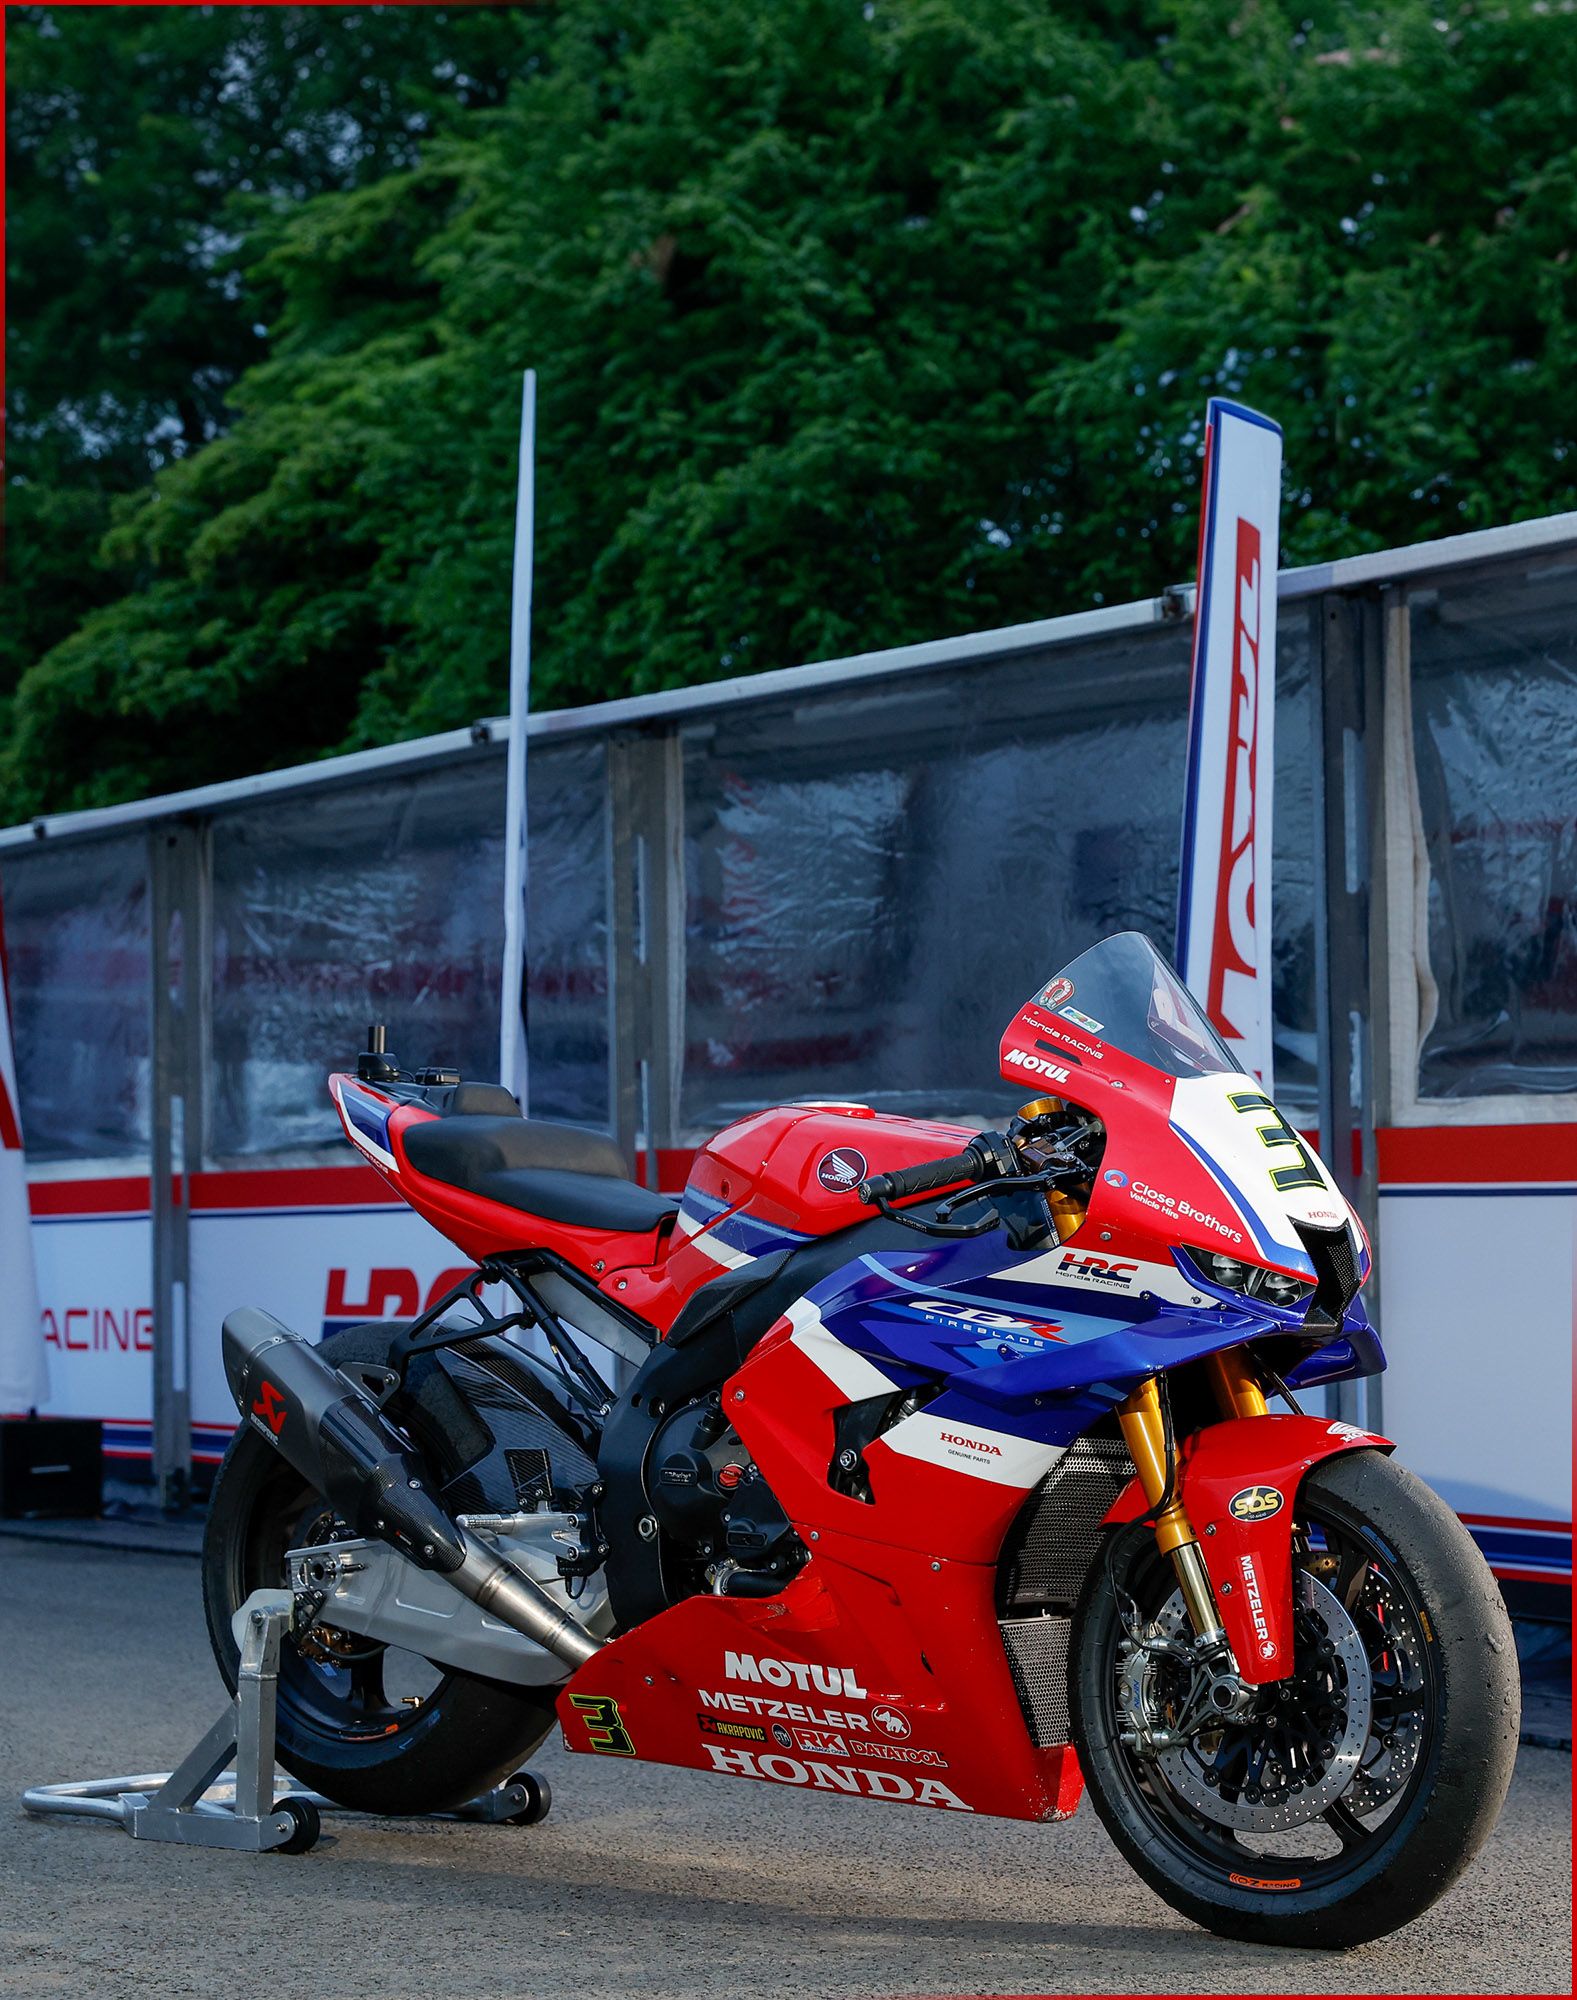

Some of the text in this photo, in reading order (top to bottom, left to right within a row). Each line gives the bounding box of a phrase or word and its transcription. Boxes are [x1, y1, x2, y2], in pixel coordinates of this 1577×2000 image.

[1022, 1015, 1061, 1038] Honda
[1061, 1035, 1104, 1060] RACING
[1003, 1049, 1071, 1084] MOTUL
[1227, 1091, 1328, 1192] 3
[820, 1172, 854, 1186] HONDA
[1130, 1191, 1179, 1220] Vehicle Hire
[1131, 1181, 1243, 1244] Close Brothers
[1056, 1270, 1131, 1289] Honda RACING
[1058, 1253, 1139, 1284] HRC
[908, 1301, 1070, 1345] CBR
[925, 1314, 1045, 1348] FIREBLADE
[940, 1431, 1003, 1457] HONDA
[947, 1449, 991, 1465] GENUINE PARTS
[1240, 1554, 1269, 1641] METZELER
[724, 1650, 868, 1700] MOTUL
[568, 1693, 637, 1756] 3
[698, 1689, 872, 1733] METZELER
[774, 1730, 791, 1743] STM
[795, 1729, 843, 1751] RK
[849, 1740, 949, 1768] DATATOOL
[701, 1743, 975, 1811] HONDA
[1261, 1881, 1297, 1889] RACING
